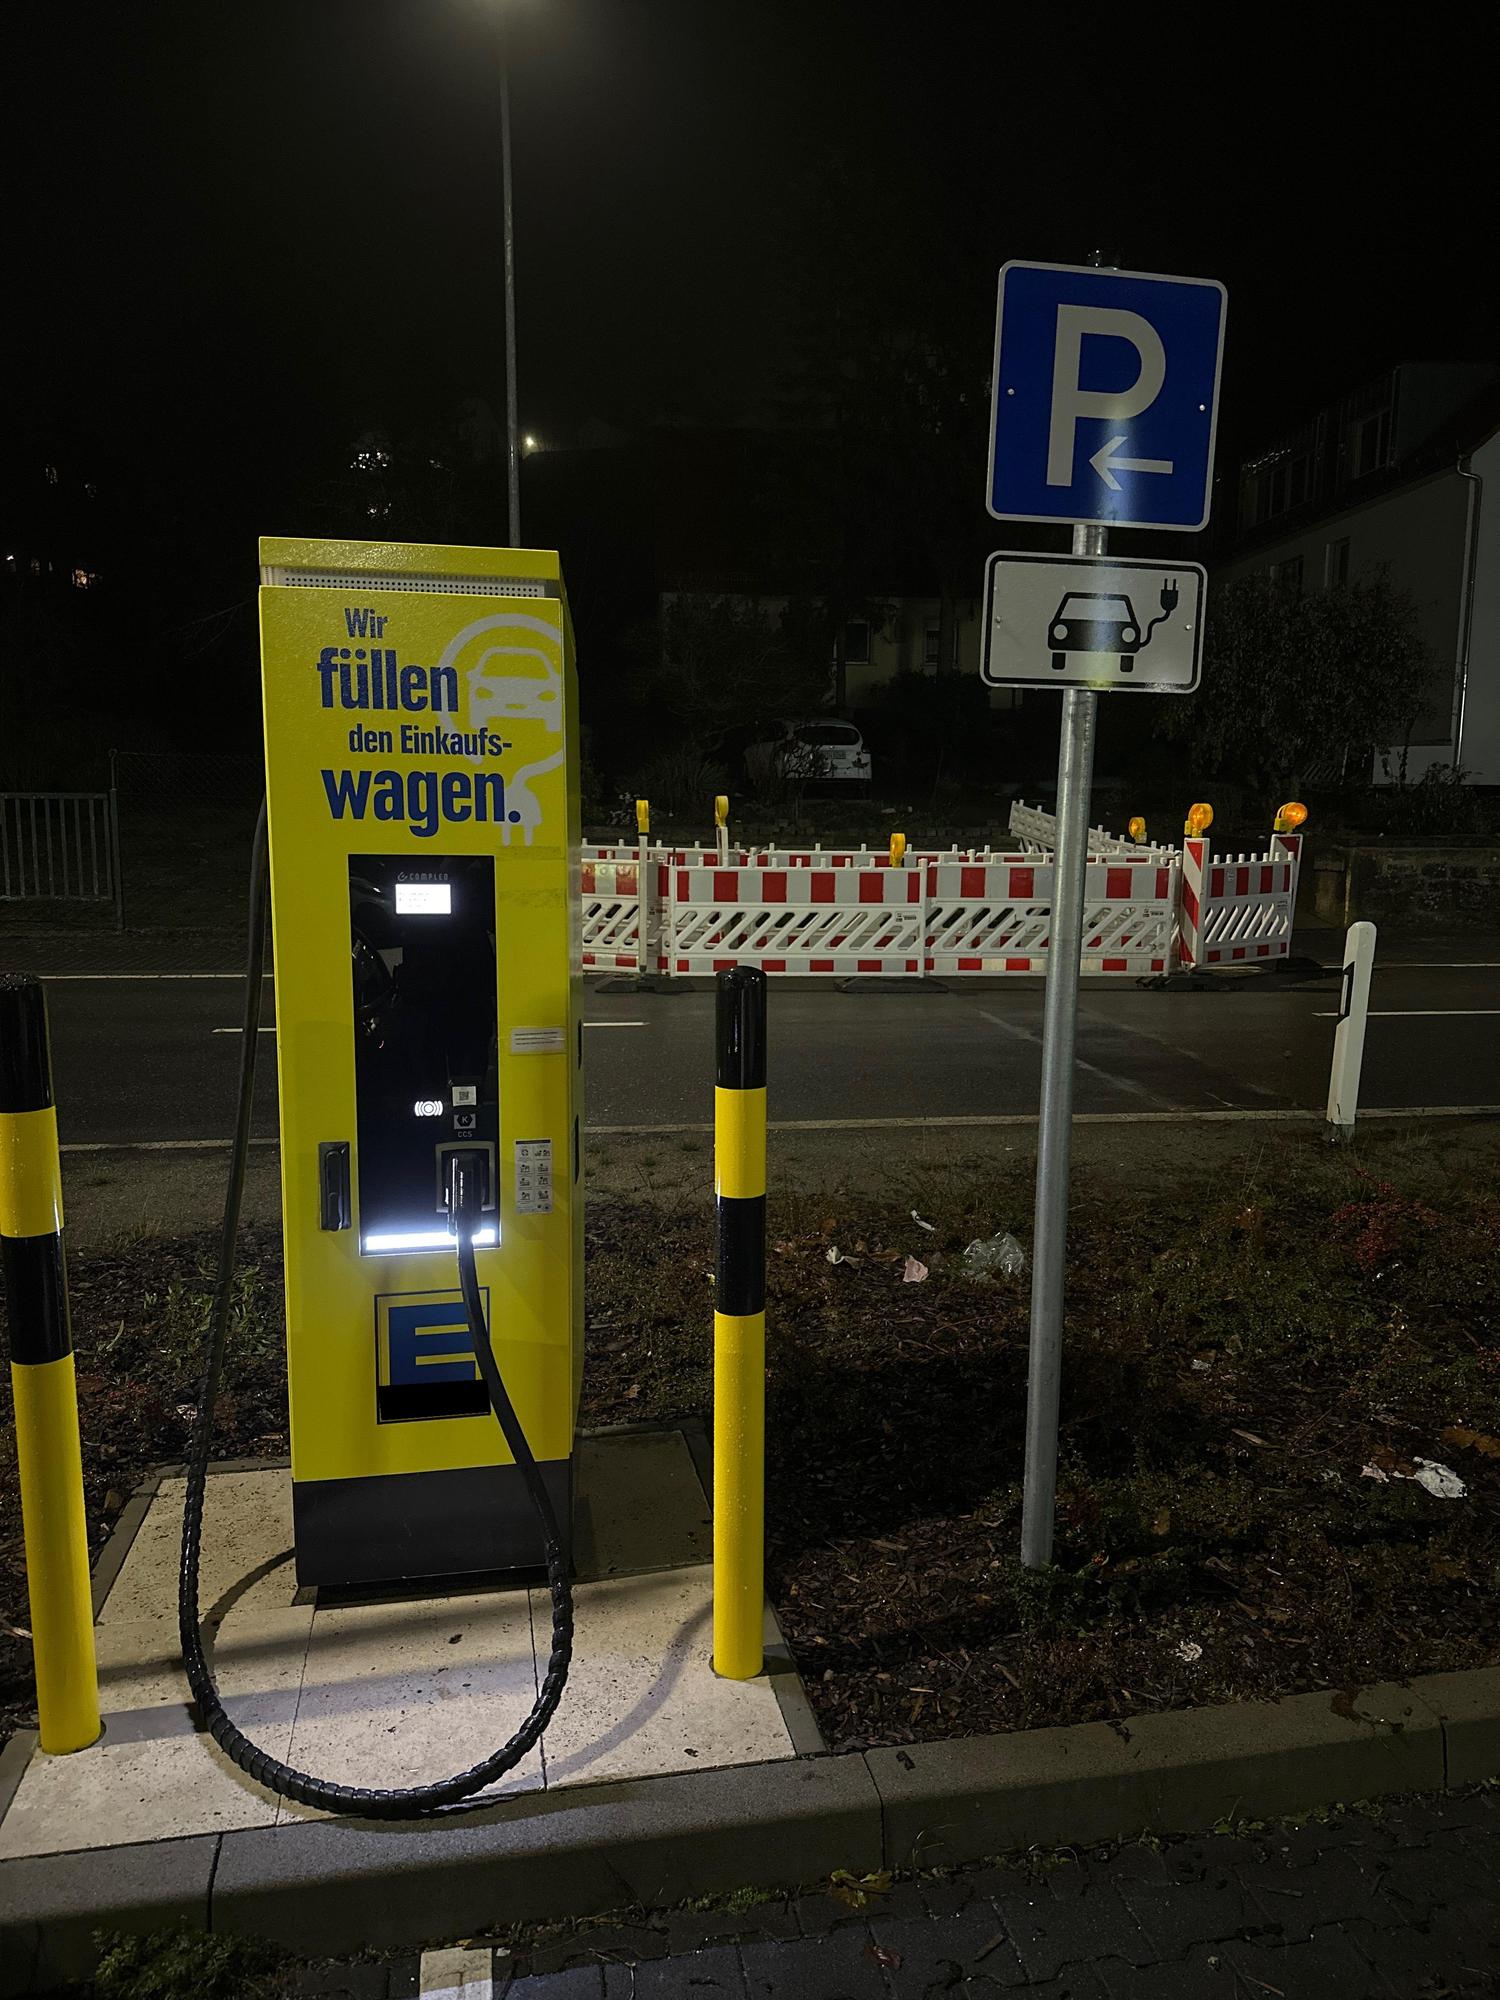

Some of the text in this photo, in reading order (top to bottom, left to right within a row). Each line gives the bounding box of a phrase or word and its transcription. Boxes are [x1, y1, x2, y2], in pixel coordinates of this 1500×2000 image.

[1046, 304, 1166, 487] P
[344, 607, 389, 639] Wir
[317, 646, 459, 713] füllen
[349, 723, 512, 757] den Einkaufs-
[320, 769, 521, 838] wagen.
[457, 1130, 473, 1138] CCS
[461, 1115, 469, 1124] K
